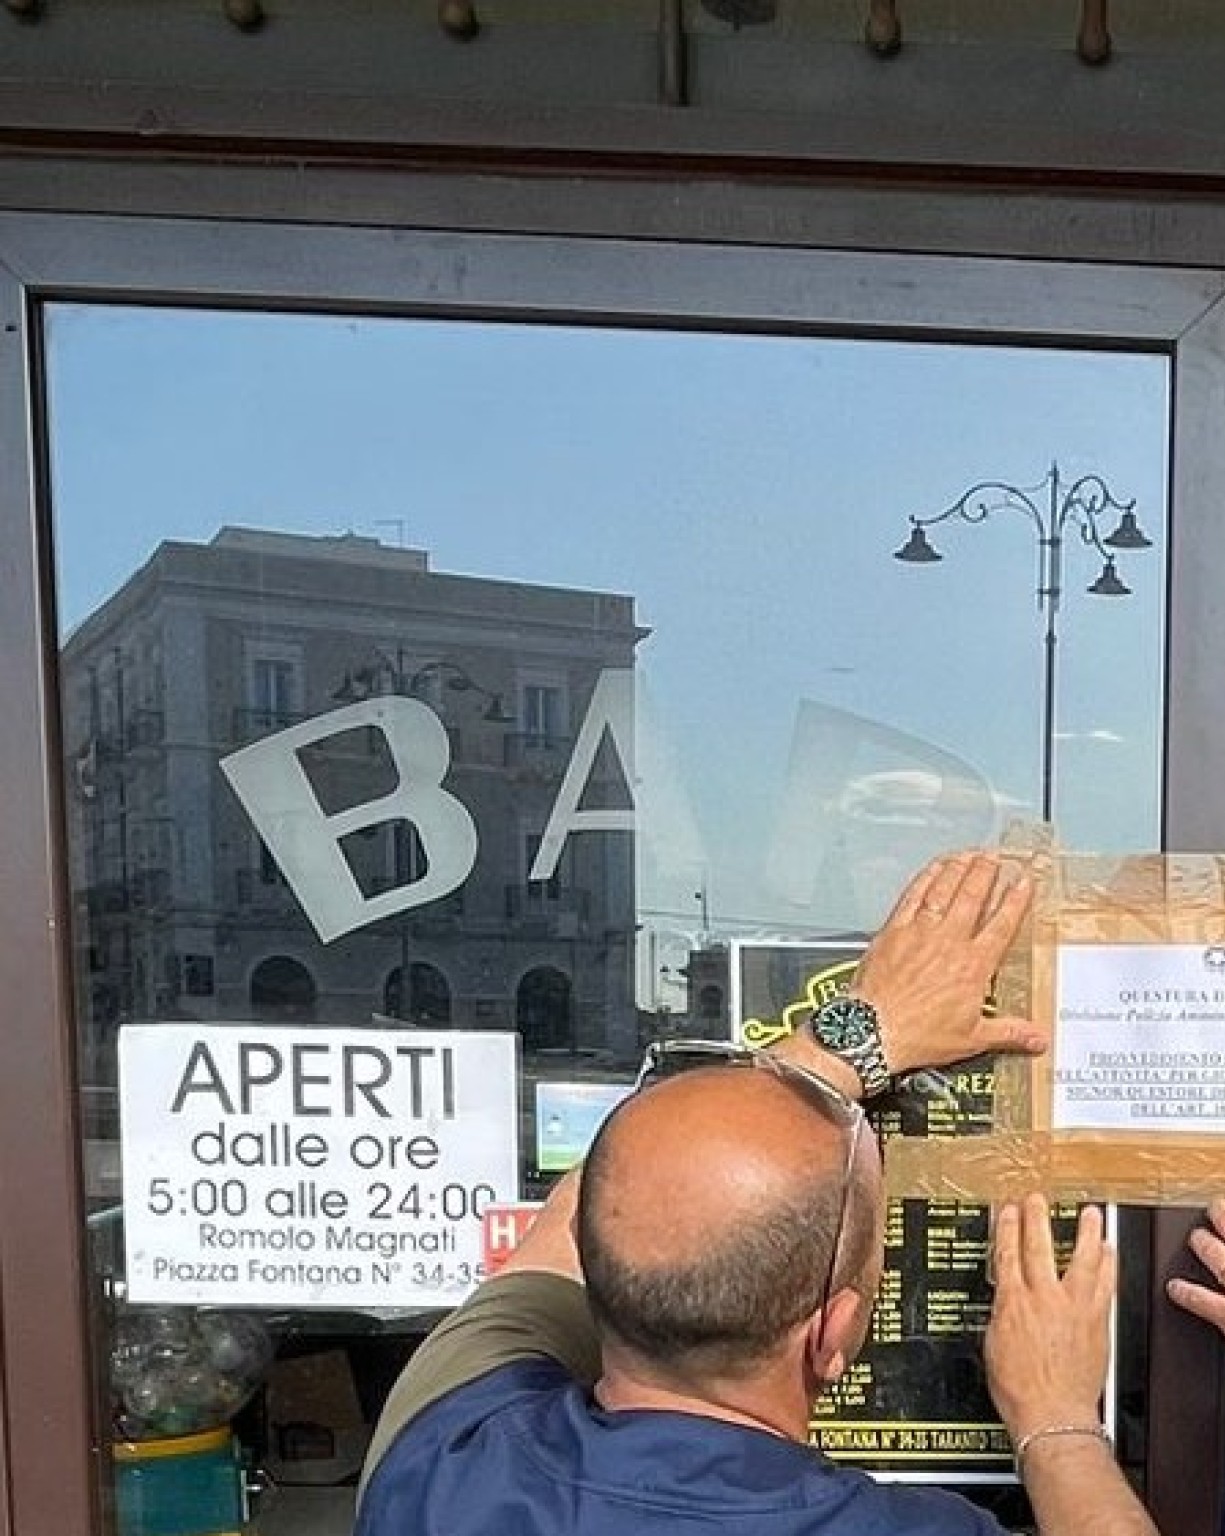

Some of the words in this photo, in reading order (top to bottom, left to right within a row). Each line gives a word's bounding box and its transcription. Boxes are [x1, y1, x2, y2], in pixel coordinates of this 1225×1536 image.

[1118, 990, 1208, 1004] QUESTURA
[170, 1040, 455, 1120] APERTI
[191, 1122, 329, 1168] dalle
[349, 1134, 440, 1170] ore
[147, 1178, 247, 1217] 5:00
[265, 1181, 349, 1219] alle
[366, 1181, 496, 1222] 24:00
[199, 1223, 315, 1252] Romolo
[325, 1225, 457, 1257] Magnati
[152, 1256, 239, 1283] Piazza
[247, 1259, 362, 1286] Fontana
